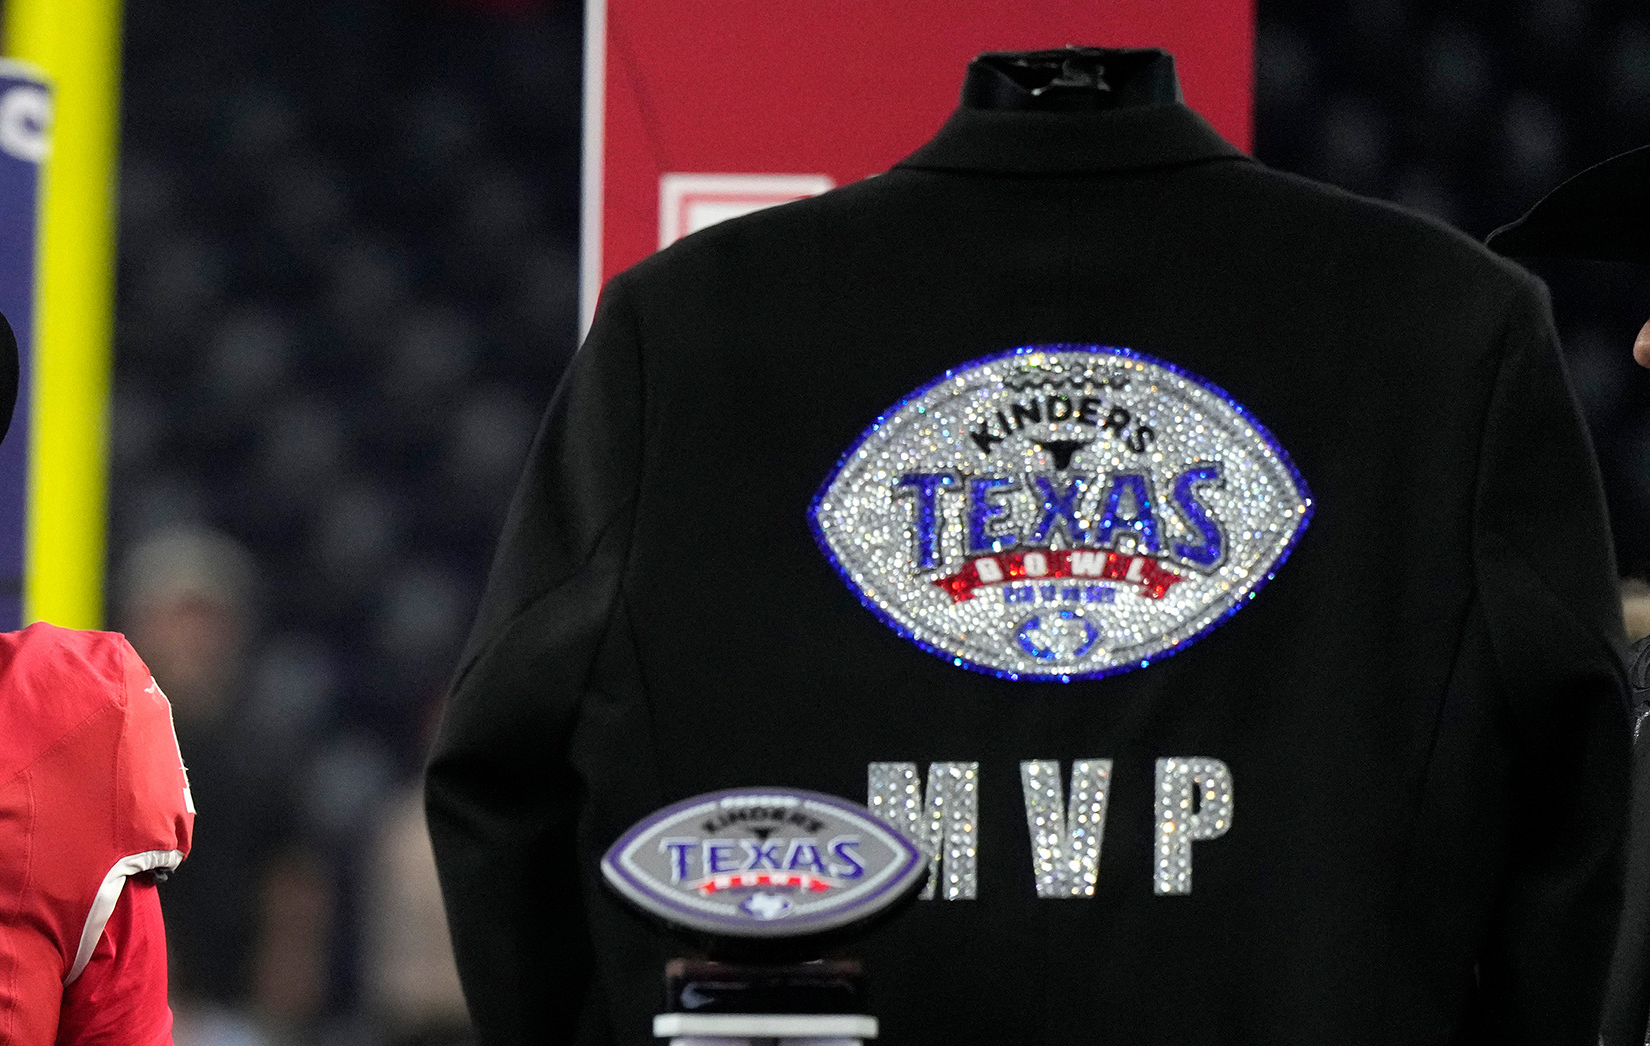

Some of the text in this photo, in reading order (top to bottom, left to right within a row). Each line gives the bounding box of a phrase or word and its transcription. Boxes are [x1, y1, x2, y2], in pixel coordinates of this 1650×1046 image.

[895, 462, 1226, 574] TEXAS
[974, 551, 1146, 584] BOWL
[658, 837, 865, 884] TEXAS
[868, 757, 1234, 899] MVP
